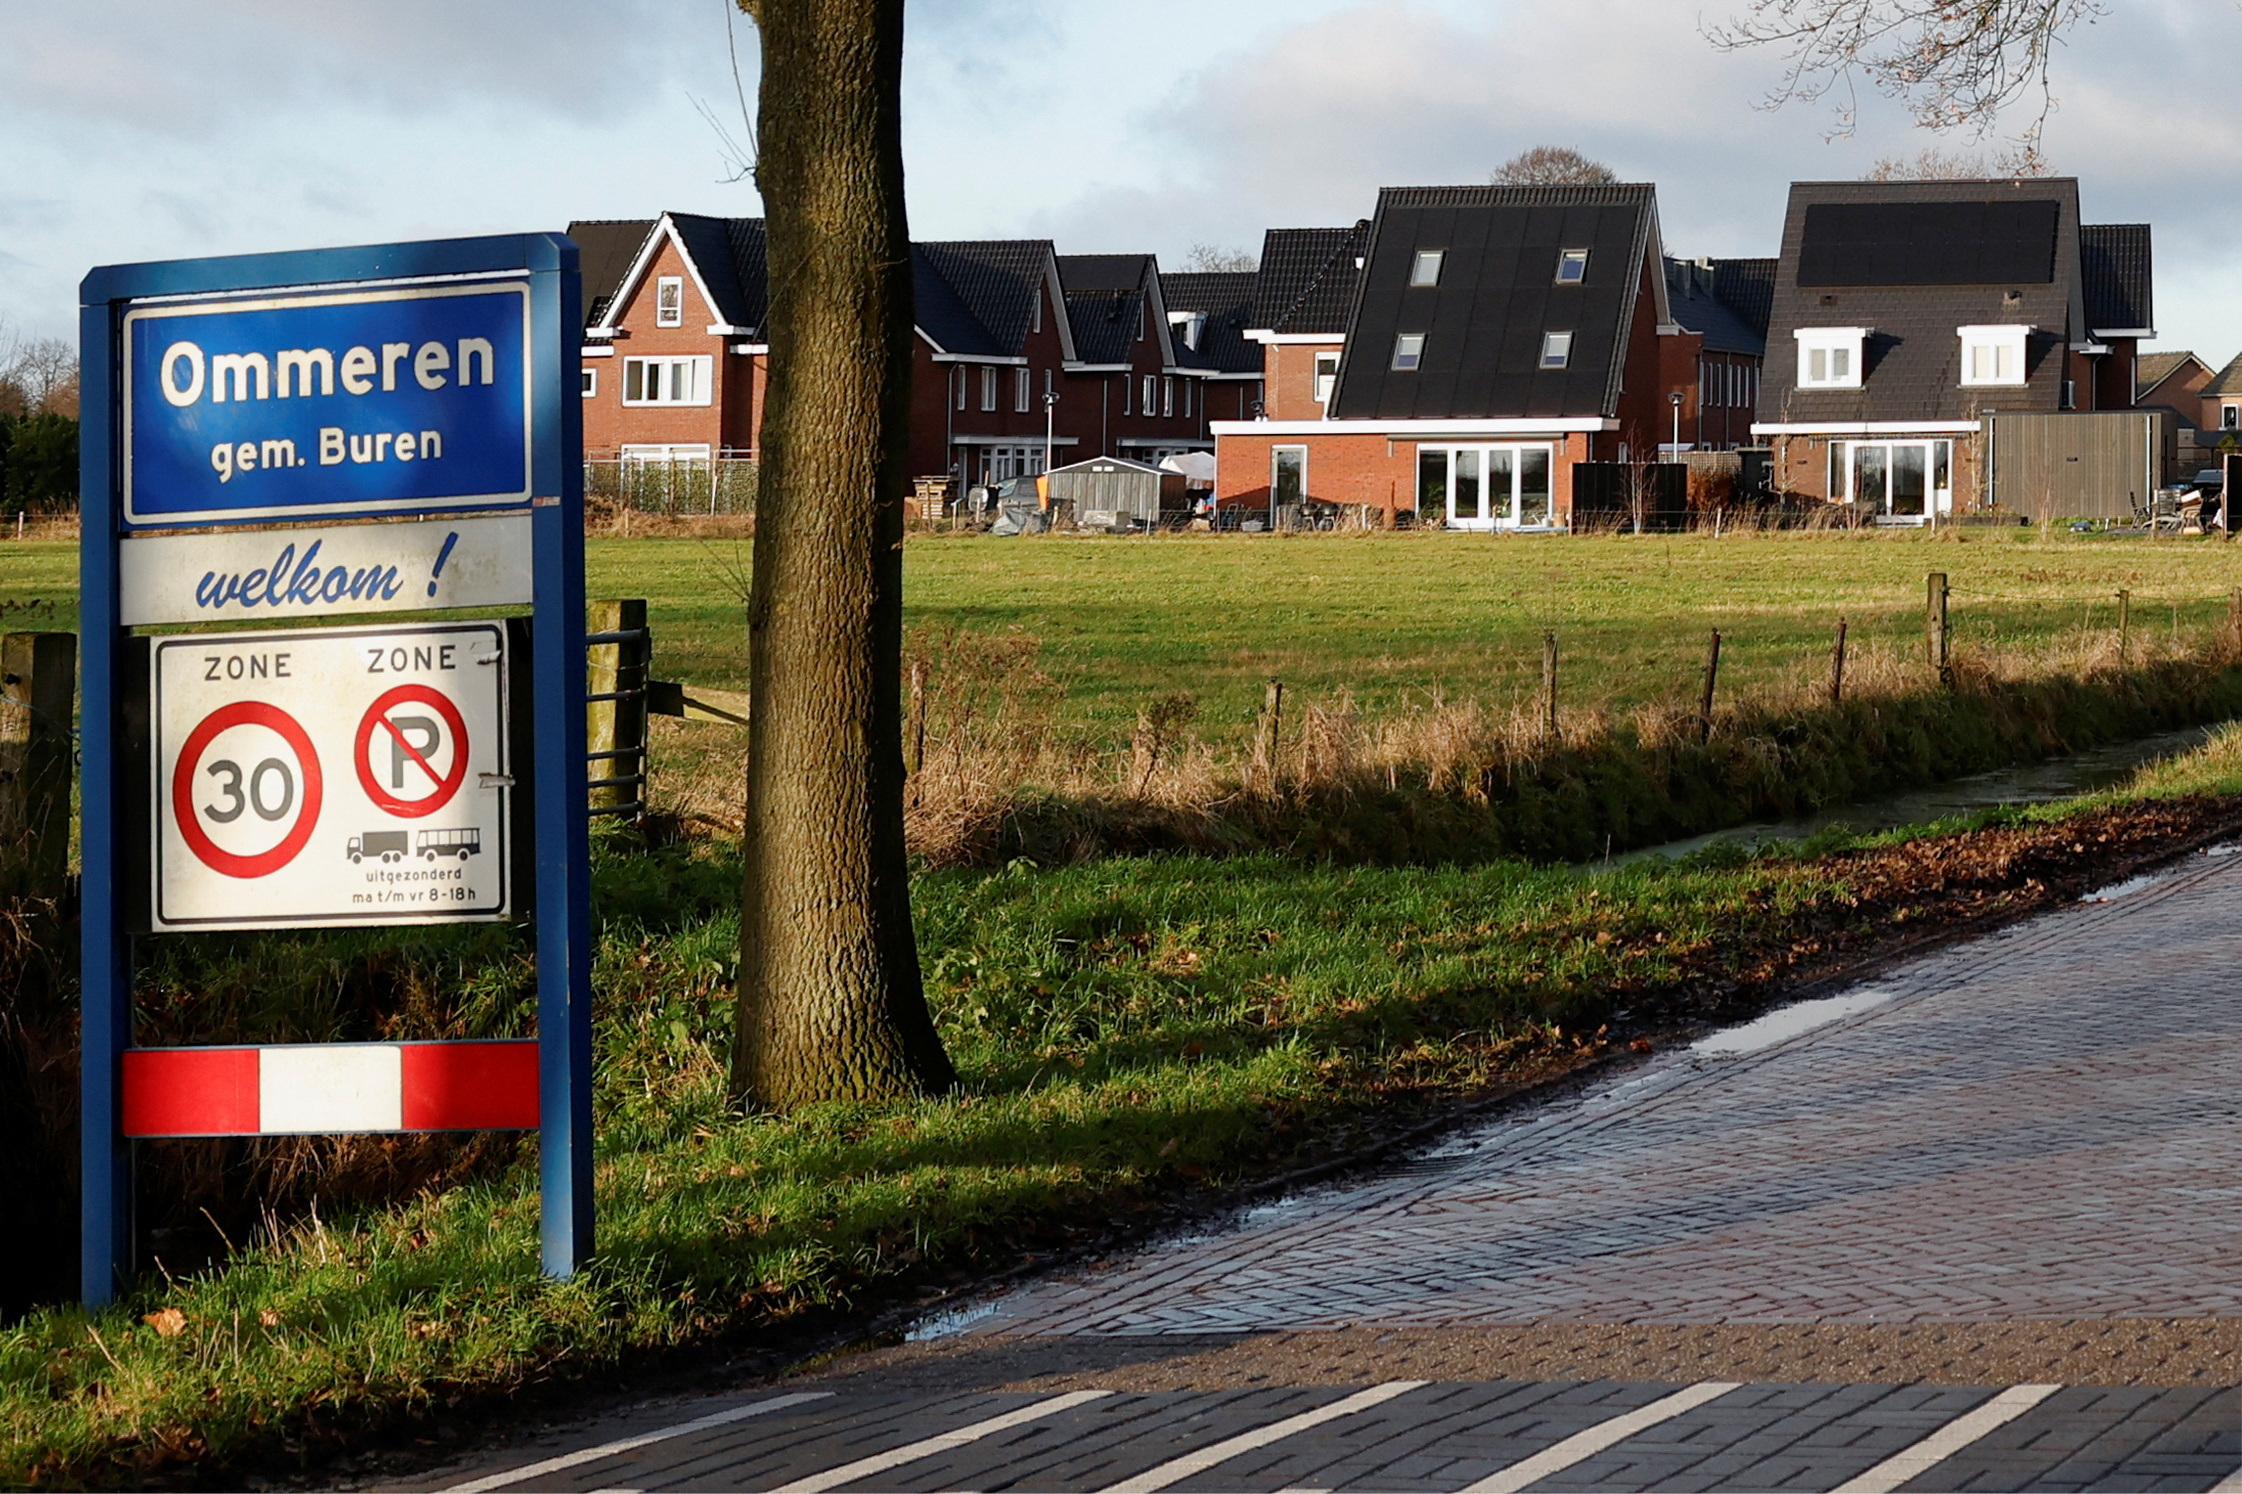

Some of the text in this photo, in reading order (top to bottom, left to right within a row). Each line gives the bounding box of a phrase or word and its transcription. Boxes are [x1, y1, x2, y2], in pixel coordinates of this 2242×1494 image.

[160, 336, 494, 408] Ommeren
[211, 426, 442, 484] gem. Buren
[195, 531, 459, 608] welkom !
[204, 652, 292, 681] ZONE
[367, 644, 457, 673] ZONE
[203, 757, 294, 824] 30
[352, 893, 373, 903] ma
[377, 890, 404, 903] t/m
[409, 891, 424, 901] vr
[366, 868, 462, 885] uitgezonderd
